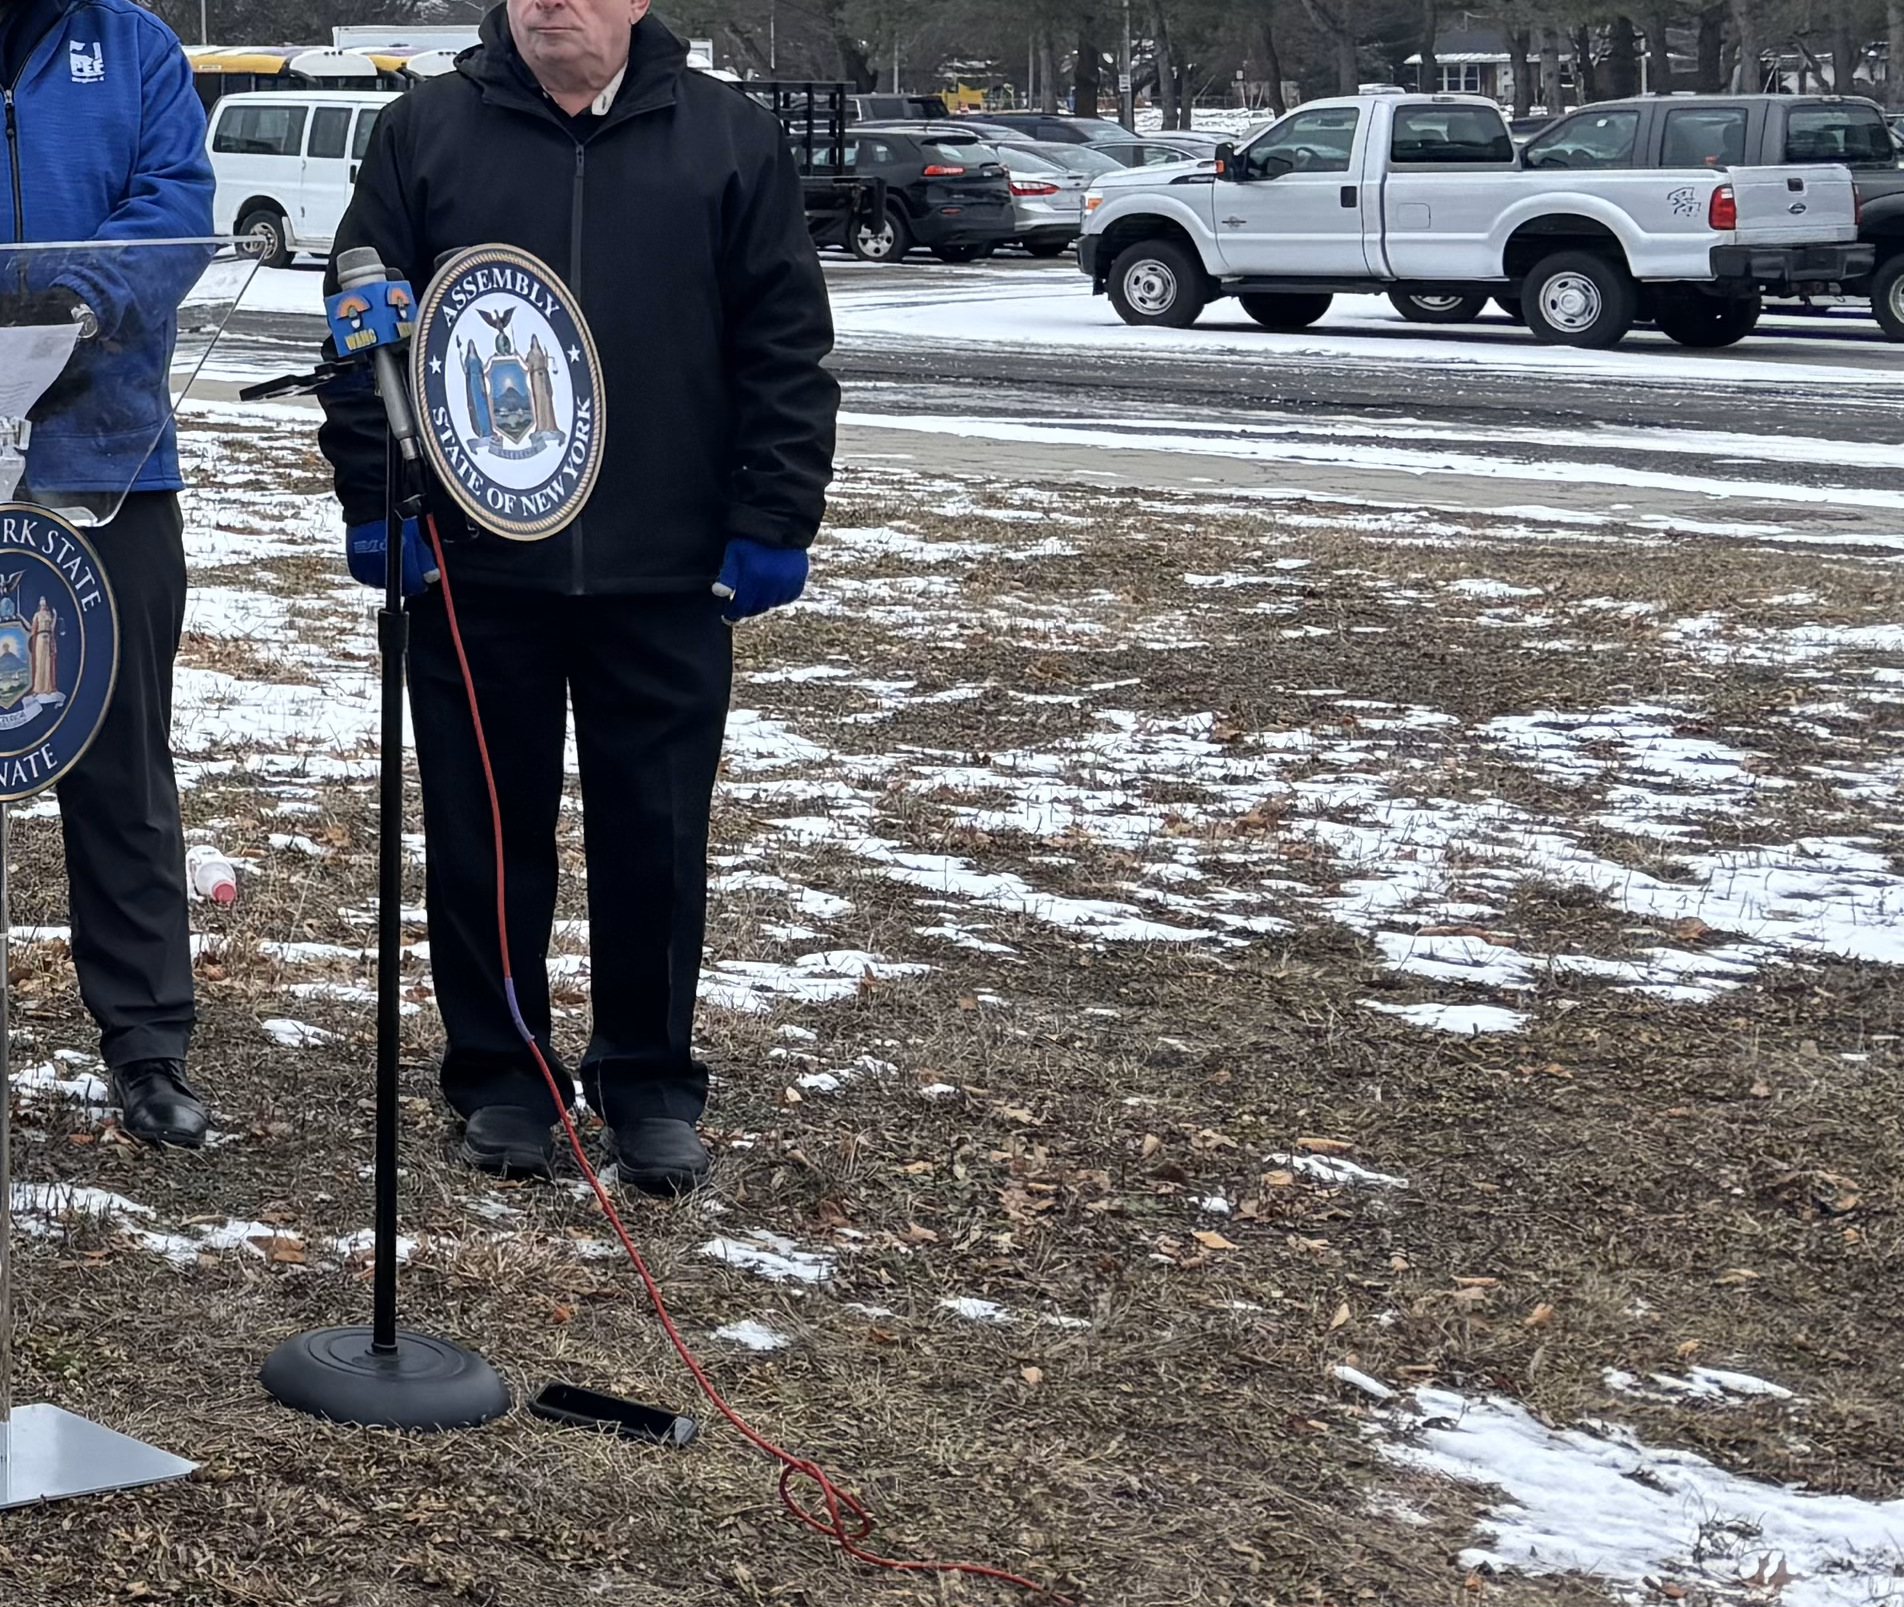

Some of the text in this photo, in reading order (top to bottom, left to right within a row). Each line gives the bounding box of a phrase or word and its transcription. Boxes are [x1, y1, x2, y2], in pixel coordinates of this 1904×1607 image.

[442, 267, 560, 328] ASSEMBLY
[433, 395, 592, 517] STATE OF NEW YORK
[41, 529, 103, 613] STATE
